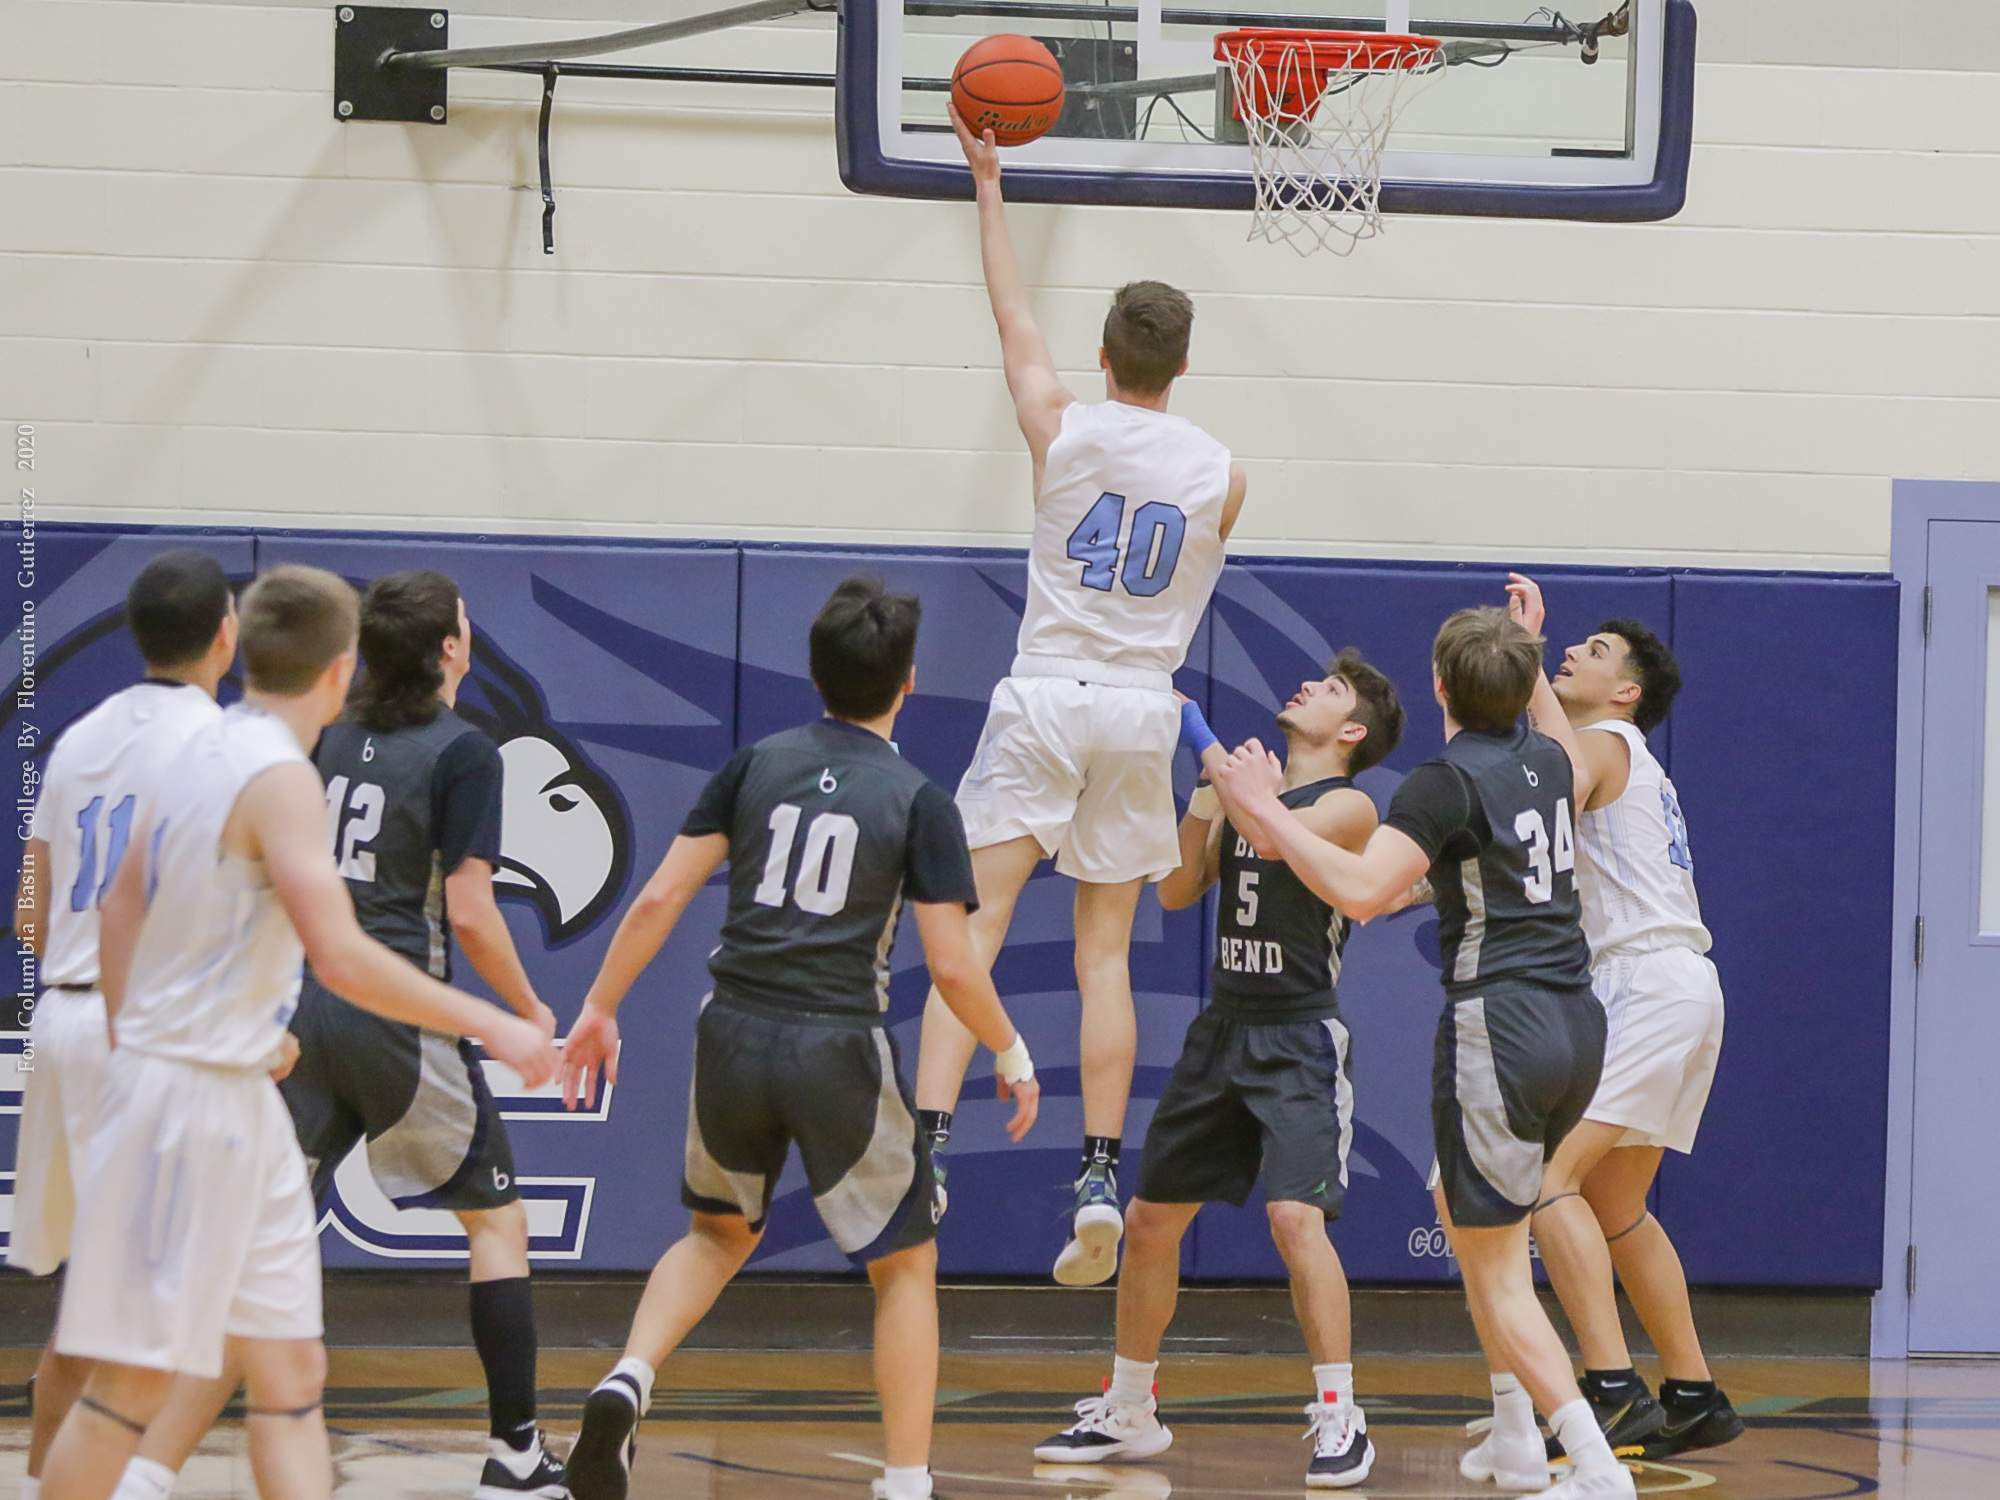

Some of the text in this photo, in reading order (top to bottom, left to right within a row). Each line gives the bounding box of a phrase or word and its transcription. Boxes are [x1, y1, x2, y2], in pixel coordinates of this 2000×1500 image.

[1066, 491, 1187, 597] 40
[70, 794, 136, 912] 11
[325, 774, 386, 882] 12
[754, 802, 860, 917] 10
[1514, 797, 1580, 905] 34
[1235, 870, 1260, 927] 5
[1221, 936, 1283, 974] BEND
